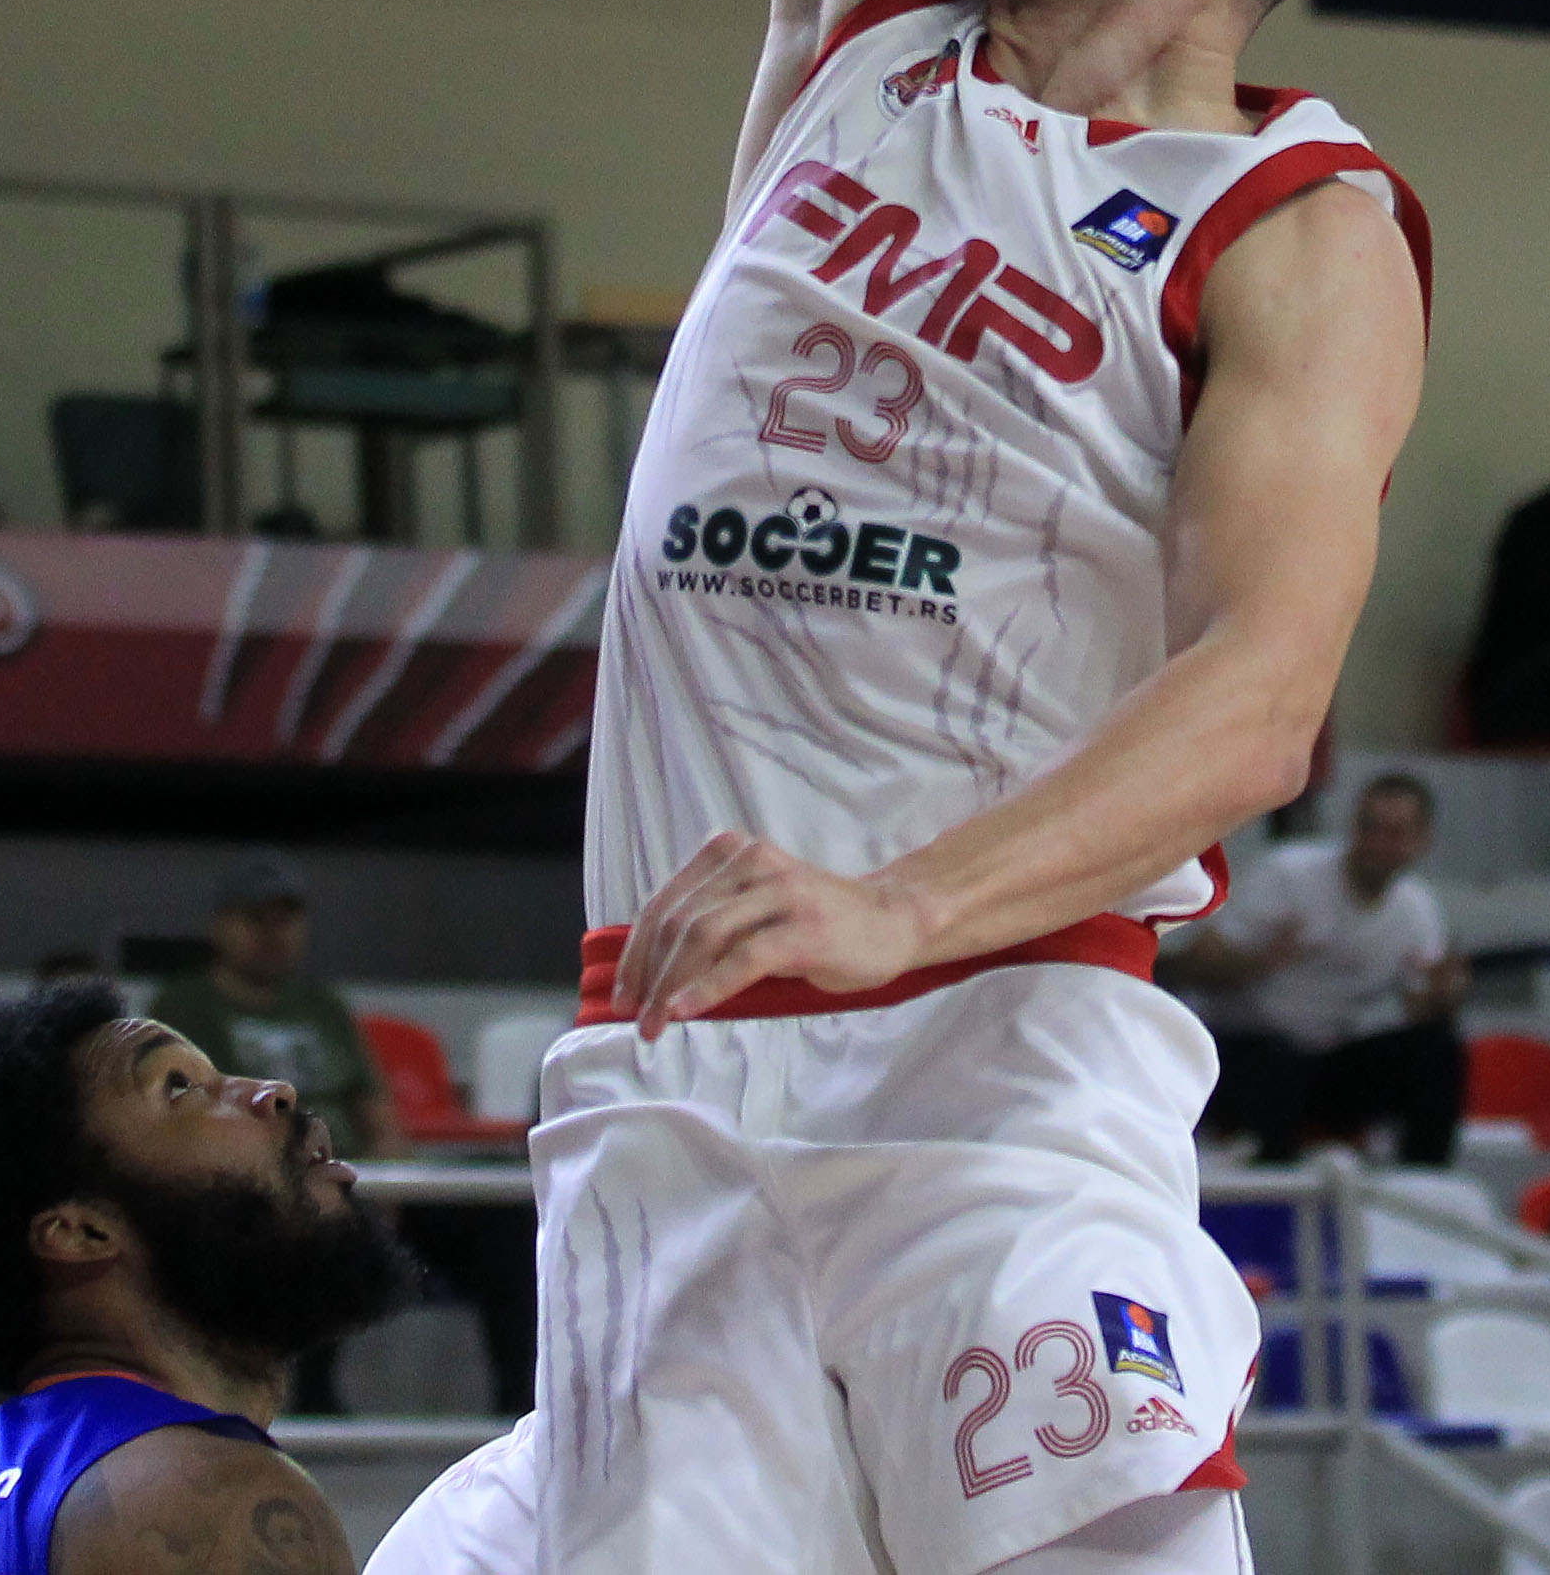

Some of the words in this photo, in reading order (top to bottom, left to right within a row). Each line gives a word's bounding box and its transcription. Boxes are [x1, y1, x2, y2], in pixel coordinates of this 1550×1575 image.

[742, 160, 1105, 385] FMP
[758, 322, 925, 464] 23
[656, 570, 959, 627] WWW.SOCCERBET.RS
[661, 503, 962, 597] SOCCER
[944, 1320, 1111, 1500] 23
